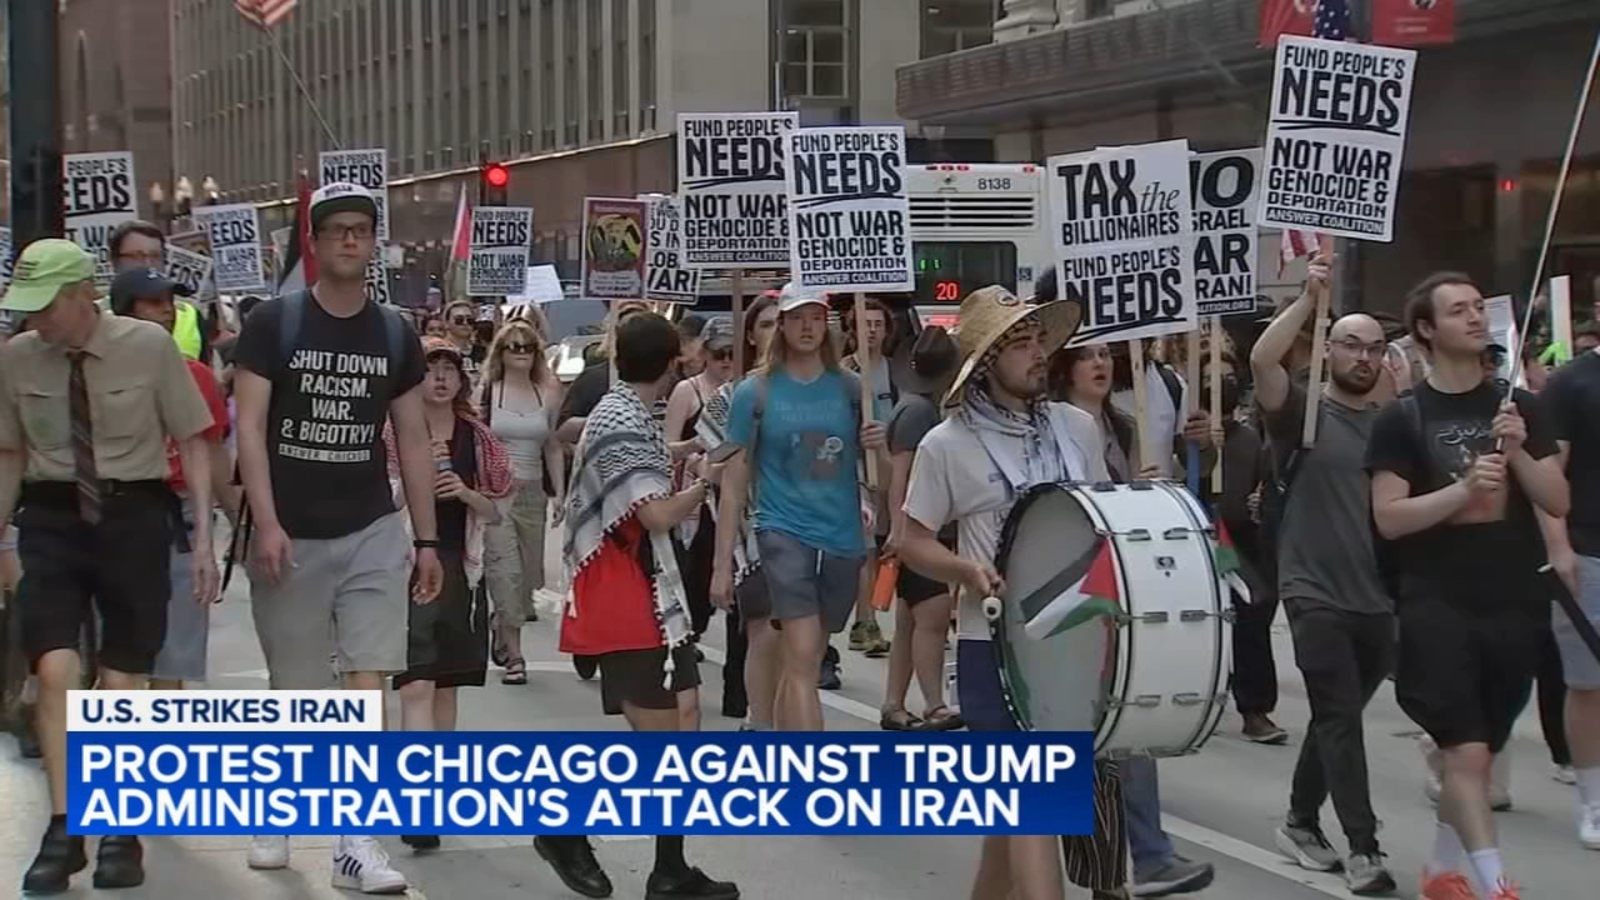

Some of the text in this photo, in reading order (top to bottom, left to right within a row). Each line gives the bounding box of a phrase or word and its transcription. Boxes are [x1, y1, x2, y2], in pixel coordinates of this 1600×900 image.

[1284, 45, 1406, 80] FUND PEOPLE'S
[1279, 68, 1402, 128] NEEDS
[685, 118, 793, 137] FUND PEOPLE'S
[791, 133, 899, 153] FUND PEOPLE'S
[1271, 137, 1392, 181] NOT WAR
[323, 163, 383, 187] NEEDS
[793, 152, 901, 195] NEEDS
[978, 178, 1011, 190] 8138
[1268, 168, 1388, 204] GENOCIDE &
[1057, 158, 1180, 221] TAX the
[685, 194, 731, 219] NOT
[1267, 191, 1386, 218] DEPORTATION
[473, 221, 528, 245] NEEDS
[685, 219, 790, 237] GENOCIDE &
[796, 210, 905, 239] NOT WAR
[1062, 210, 1180, 246] BILLIONAIRES
[1266, 208, 1384, 234] ANSWER COALITION
[799, 237, 905, 259] GENOCIDE &
[471, 253, 525, 269] NOT WAR
[801, 257, 907, 271] DEPORTATION
[1063, 246, 1180, 281] FUND PEOPLE'S
[803, 272, 906, 286] ANSWER COALITION
[936, 283, 959, 300] 20
[1065, 268, 1183, 327] NEEDS
[289, 350, 388, 376] SHUT DOWN
[300, 373, 371, 398] RACISM.
[311, 398, 354, 421] WAR.
[280, 418, 375, 445] & BIGOTRY!
